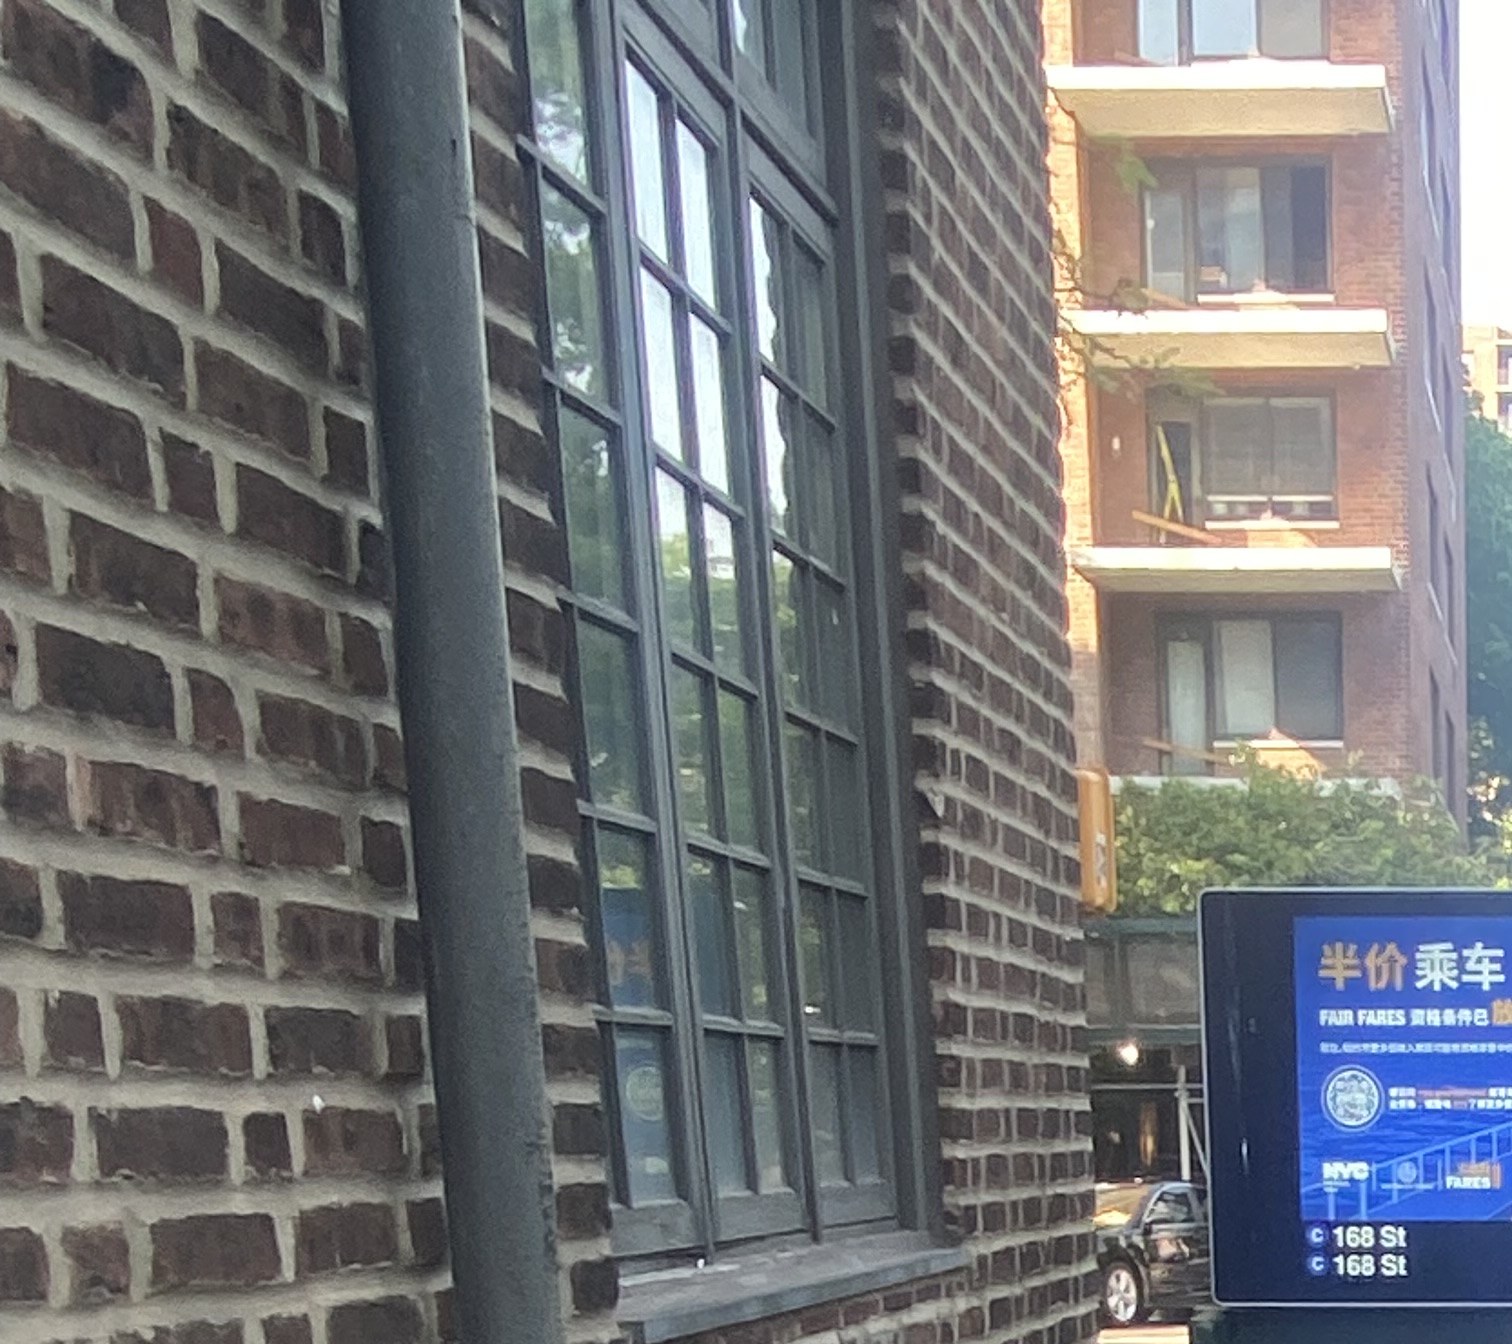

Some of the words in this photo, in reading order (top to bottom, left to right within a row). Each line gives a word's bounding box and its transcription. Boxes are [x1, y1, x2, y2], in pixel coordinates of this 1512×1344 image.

[1319, 1009, 1354, 1026] FAIR
[1357, 1009, 1406, 1026] FARES
[1322, 1161, 1370, 1181] NYC
[1333, 1225, 1375, 1248] 168
[1379, 1225, 1407, 1248] St
[1333, 1254, 1376, 1276] 168
[1380, 1254, 1408, 1276] St
